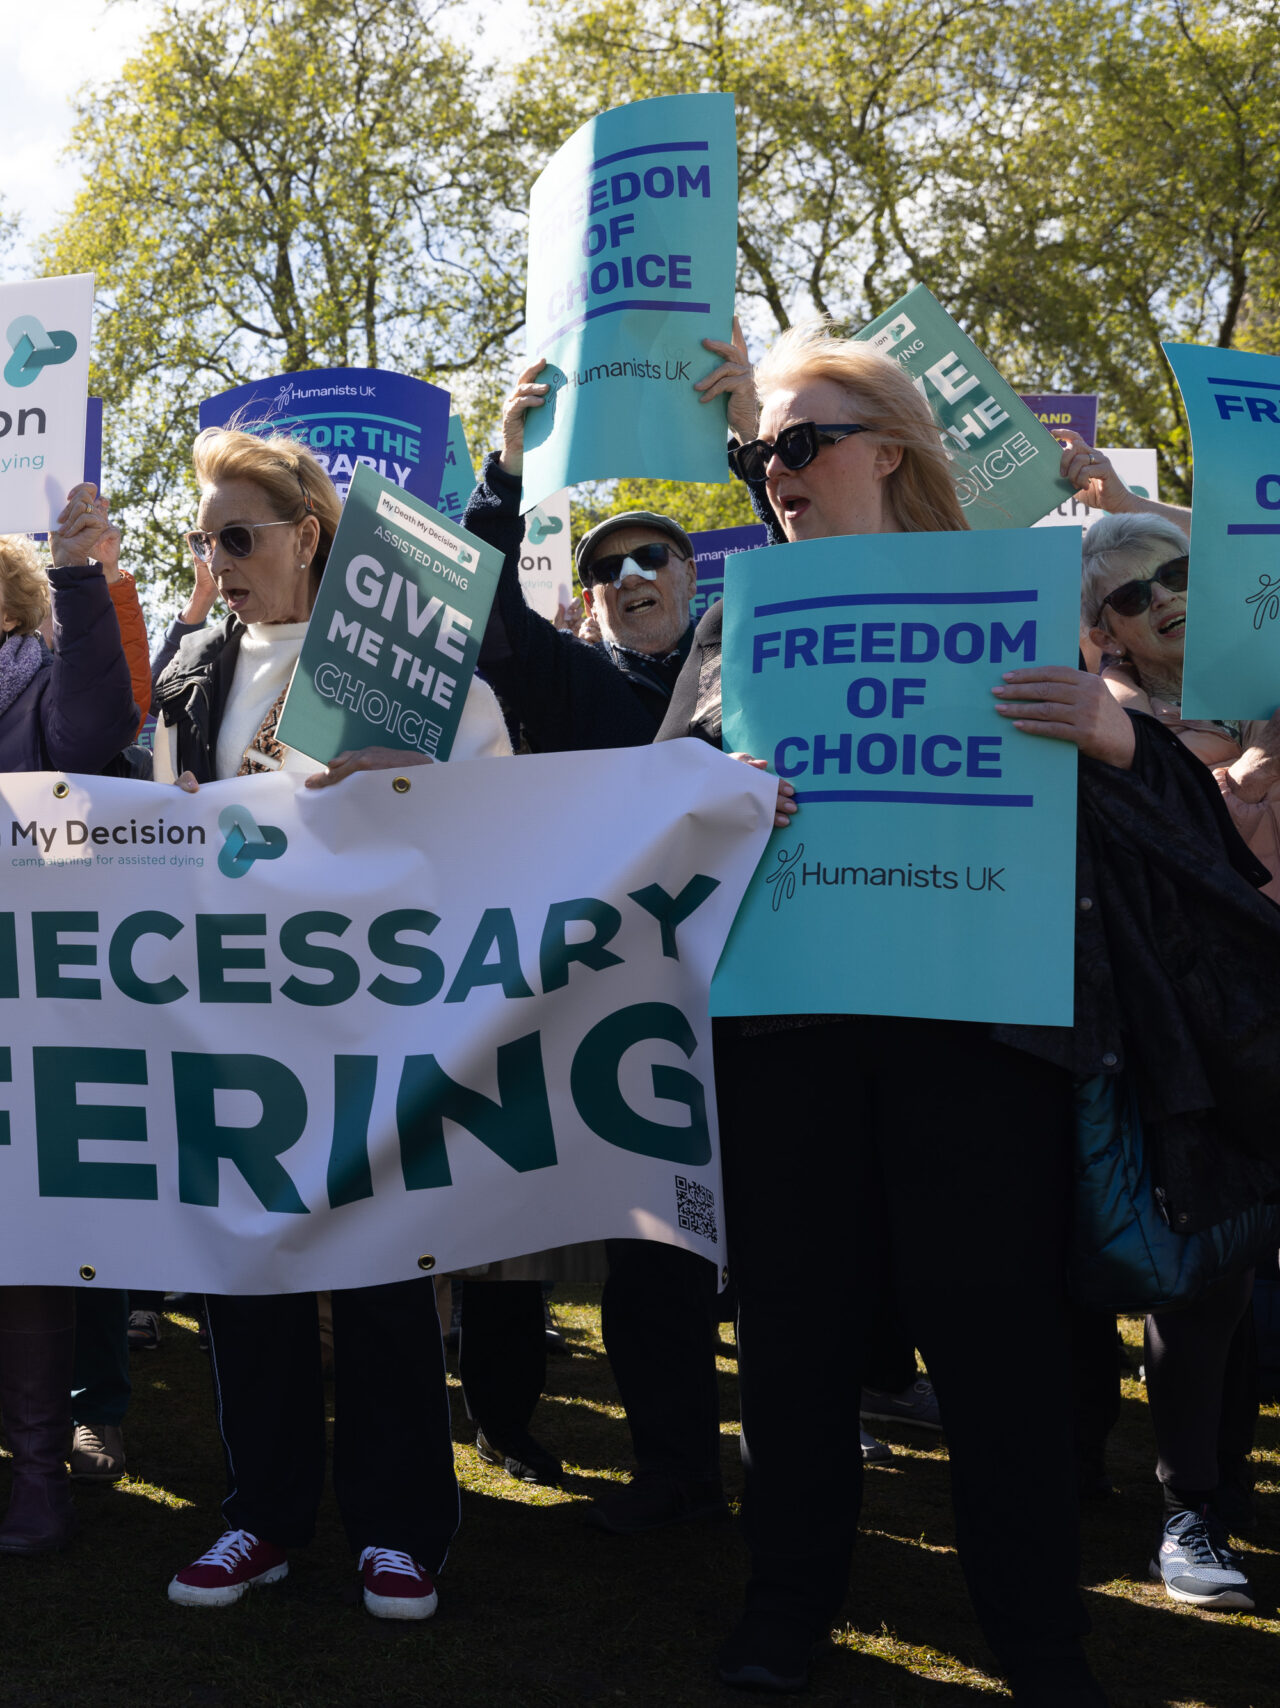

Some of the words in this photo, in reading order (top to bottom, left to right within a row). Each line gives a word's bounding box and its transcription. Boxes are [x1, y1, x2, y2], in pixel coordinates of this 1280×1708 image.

[582, 212, 635, 258] OF
[548, 253, 692, 323] CHOICE
[567, 358, 661, 392] Humanists
[665, 360, 691, 382] UK
[894, 339, 925, 365] YING
[291, 384, 357, 400] Humanists
[359, 385, 376, 397] UK
[361, 426, 421, 464] THE
[940, 395, 1010, 460] HE
[954, 431, 1039, 508] OICE
[381, 498, 394, 513] My
[394, 506, 416, 525] Death
[417, 519, 430, 536] My
[428, 526, 459, 551] Decision
[374, 525, 431, 567] ASSISTED
[432, 559, 469, 591] DYING
[692, 545, 746, 563] umanists
[345, 554, 473, 664] GIVE
[327, 609, 384, 667] ME
[391, 644, 457, 710] THE
[752, 620, 1038, 673] FREEDOM
[314, 662, 442, 757] CHOICE
[846, 677, 927, 719] OF
[774, 733, 1003, 779] CHOICE
[11, 820, 57, 853] My
[66, 818, 206, 846] Decision
[11, 855, 92, 868] campaigning
[96, 854, 114, 865] for
[117, 854, 167, 866] assisted
[169, 854, 204, 867] dying
[802, 862, 959, 890] Humanists
[966, 864, 1006, 893] UK
